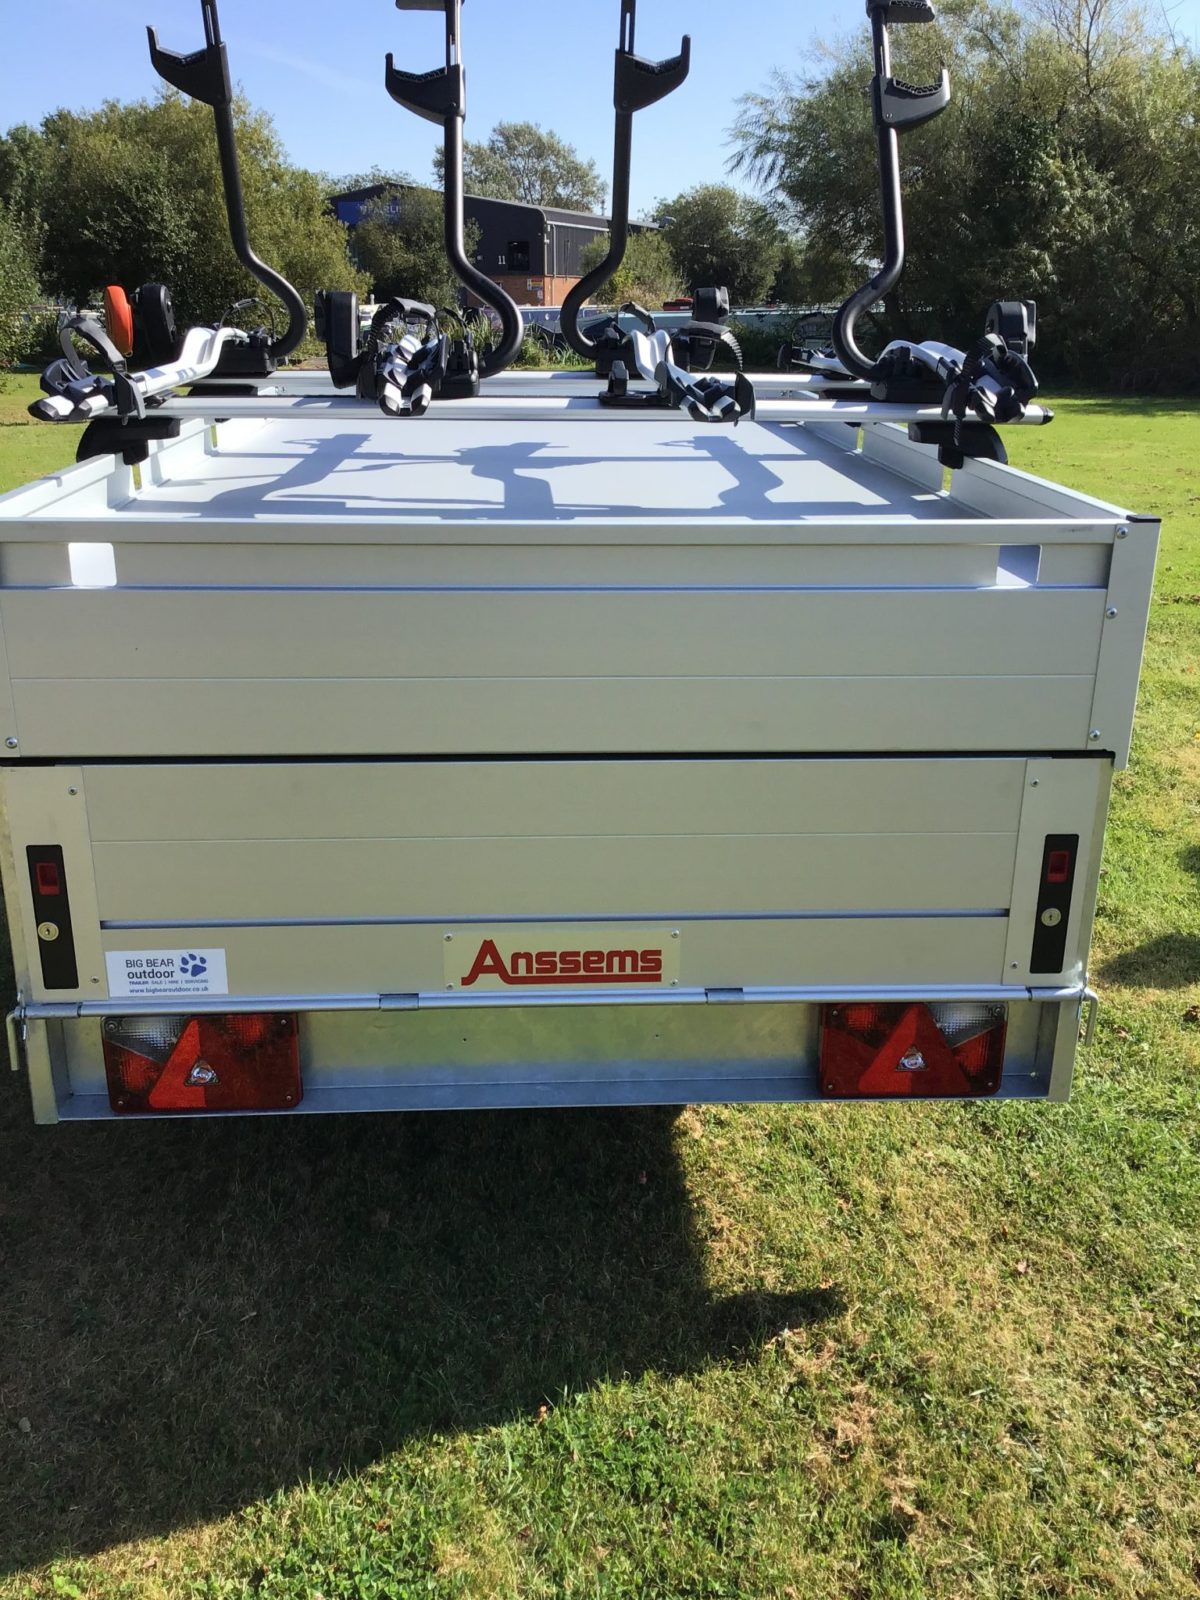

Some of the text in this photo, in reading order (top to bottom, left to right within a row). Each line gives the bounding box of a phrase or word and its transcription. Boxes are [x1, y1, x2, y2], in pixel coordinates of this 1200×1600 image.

[125, 958, 174, 968] BIG BEAR
[461, 939, 662, 986] Anssems
[127, 968, 175, 979] outdoor
